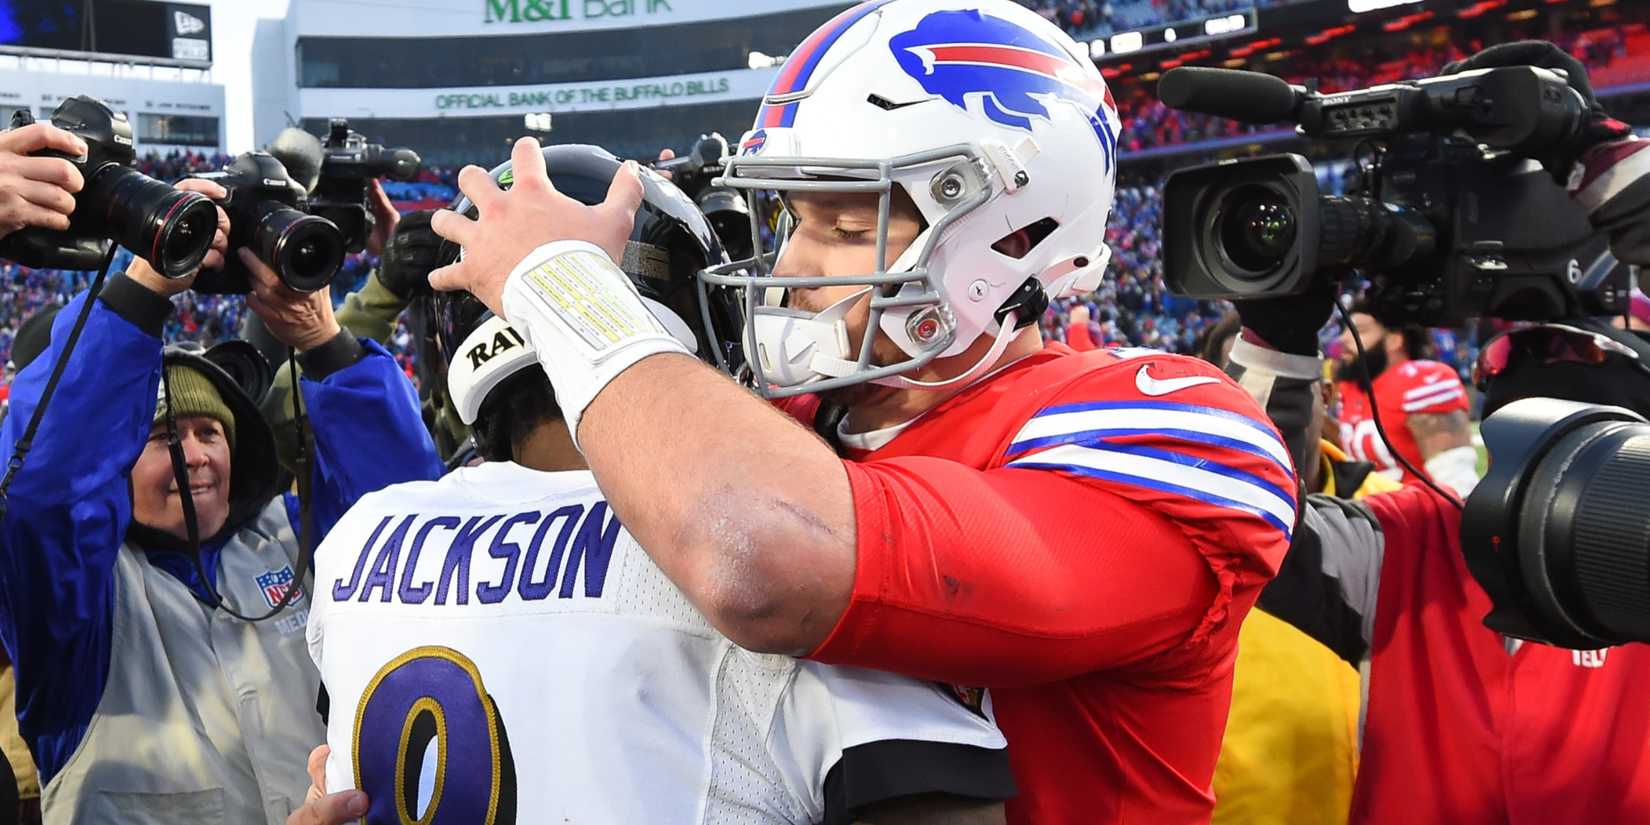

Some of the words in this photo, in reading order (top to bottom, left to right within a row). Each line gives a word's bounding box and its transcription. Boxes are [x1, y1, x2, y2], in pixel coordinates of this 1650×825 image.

[436, 94, 504, 109] OFFICIAL
[509, 91, 553, 107] BANK
[555, 89, 575, 104] OF
[579, 87, 611, 103] THE
[615, 82, 684, 101] BUFFALO
[687, 78, 729, 96] BILLS
[1567, 258, 1583, 284] 6
[332, 500, 622, 606] JACKSON
